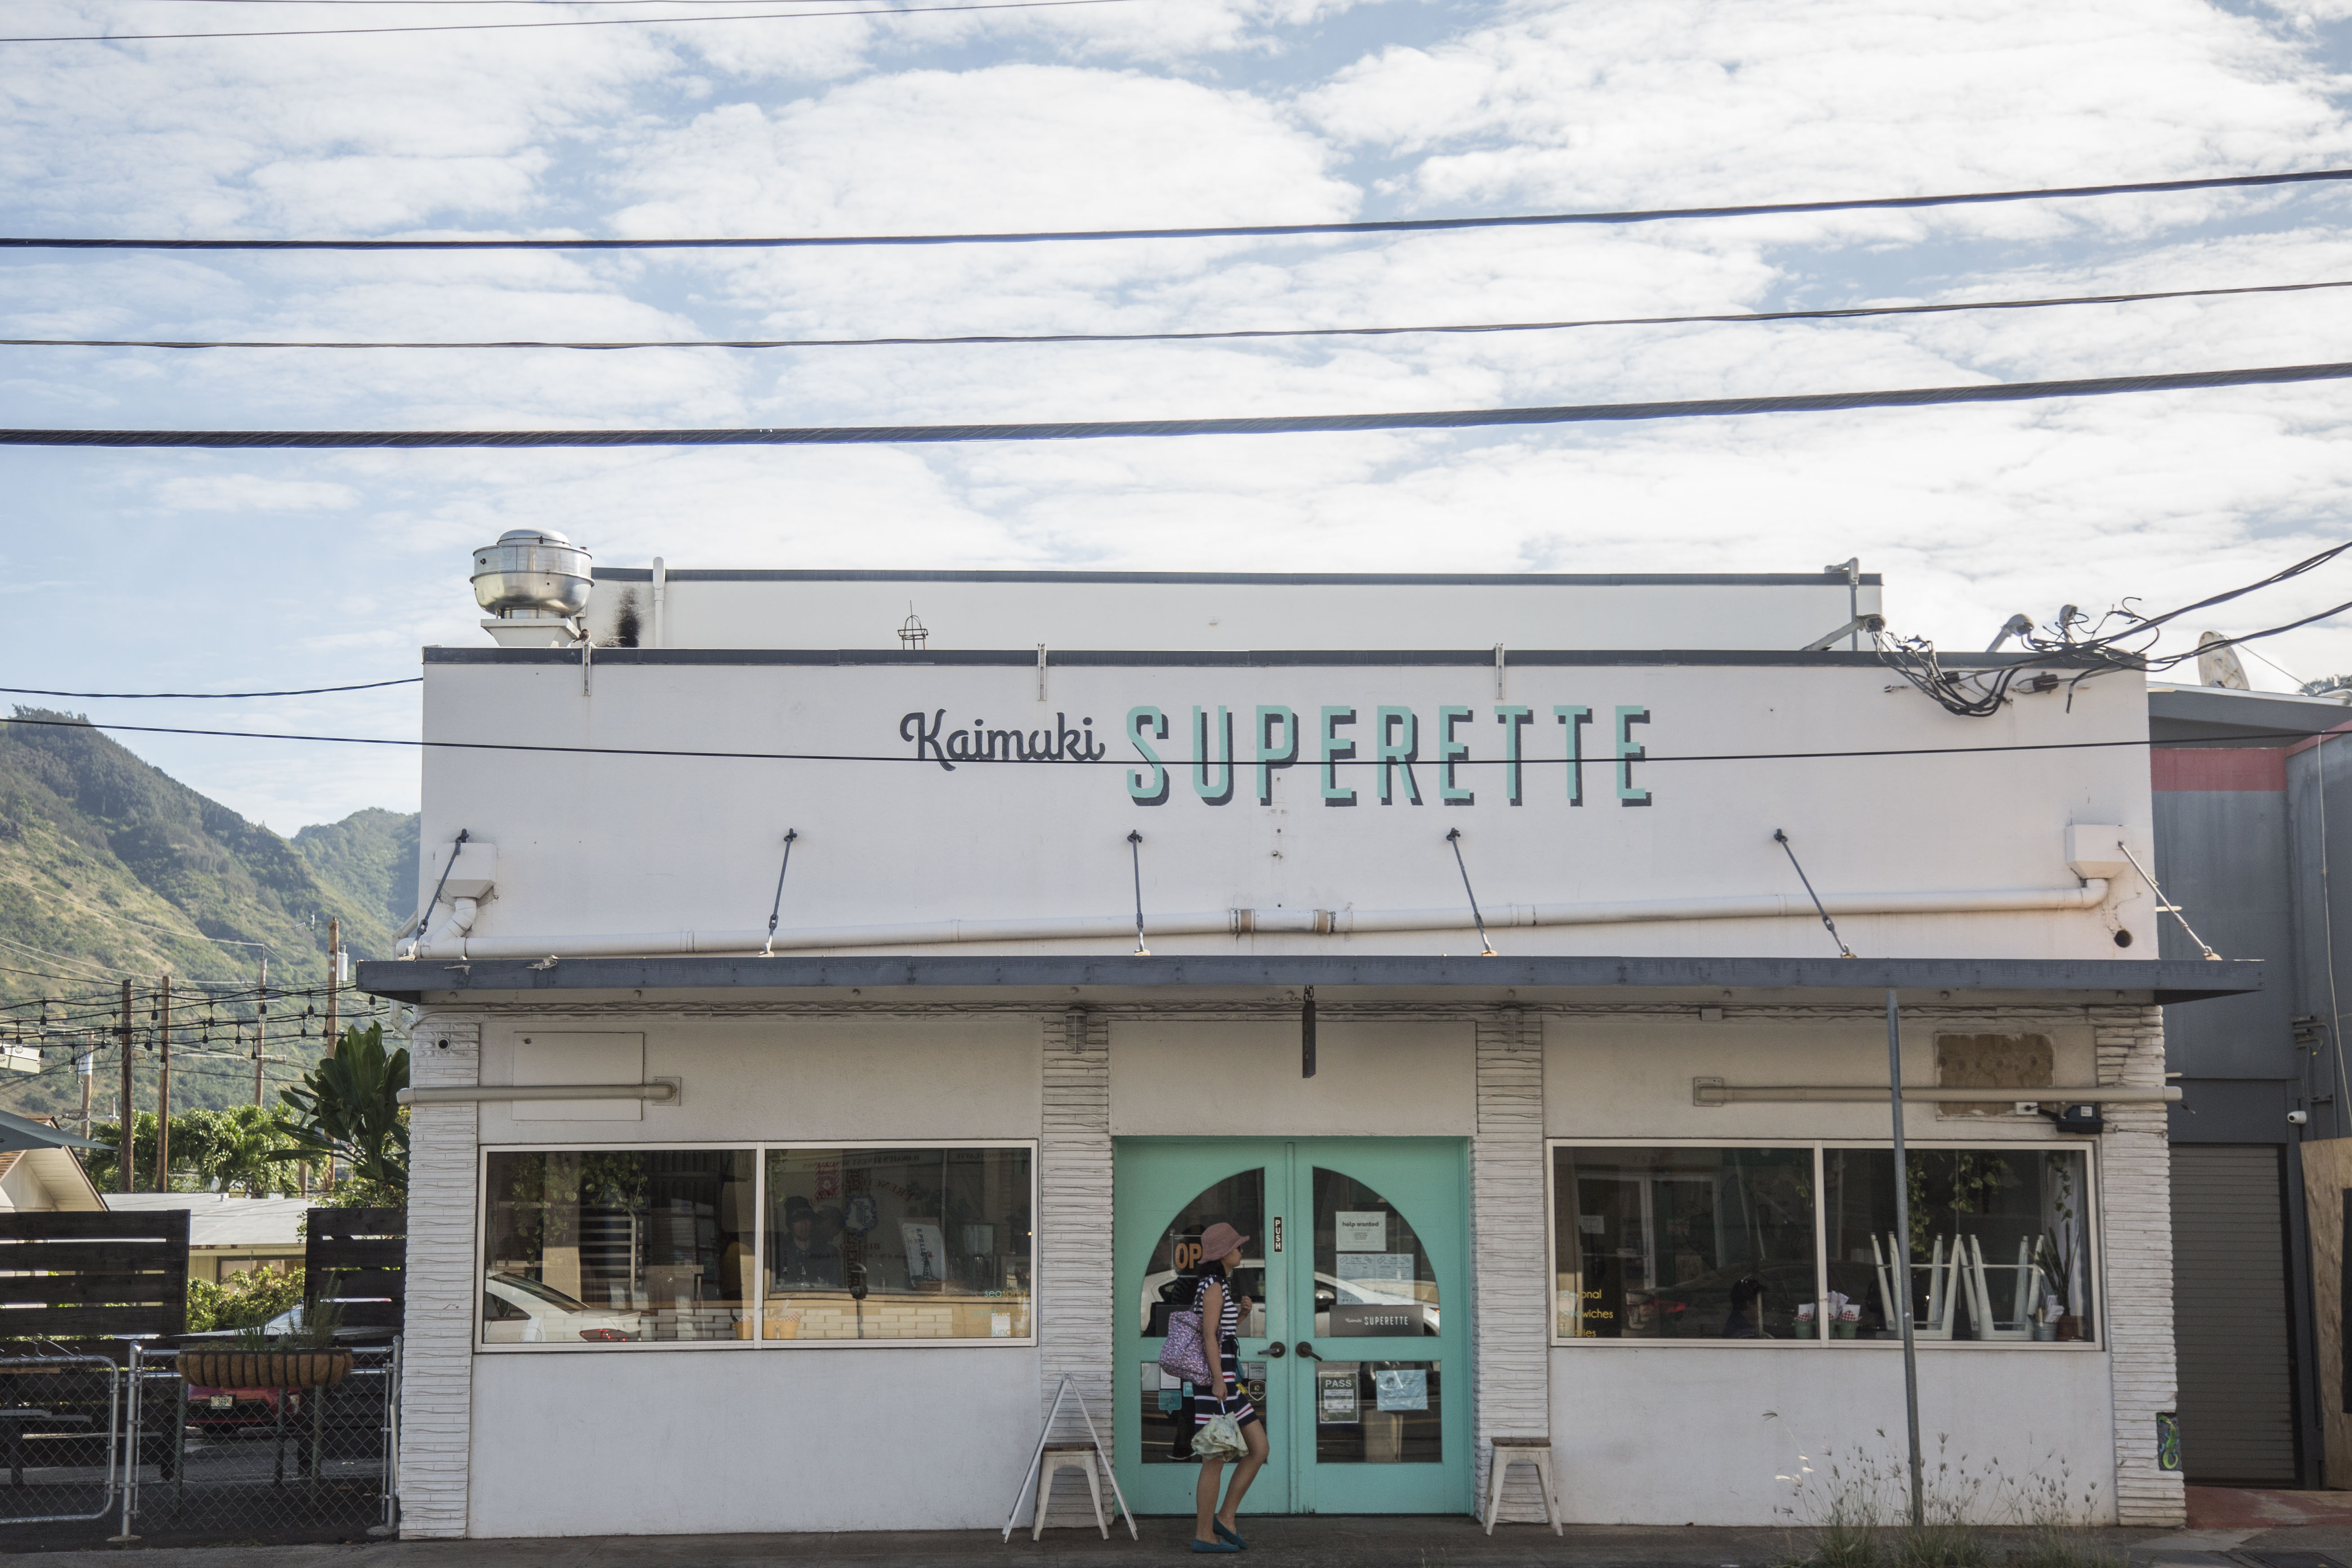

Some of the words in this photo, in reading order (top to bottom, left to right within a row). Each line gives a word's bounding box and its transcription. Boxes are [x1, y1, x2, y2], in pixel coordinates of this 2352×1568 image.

[900, 708, 1106, 771] Kaimuki
[1127, 704, 1653, 807] SUPERETTE
[1175, 1242, 1202, 1270] OP
[984, 1287, 1028, 1297] seasonal
[1364, 1316, 1408, 1326] SUPERETTE
[1325, 1379, 1352, 1388] PASS
